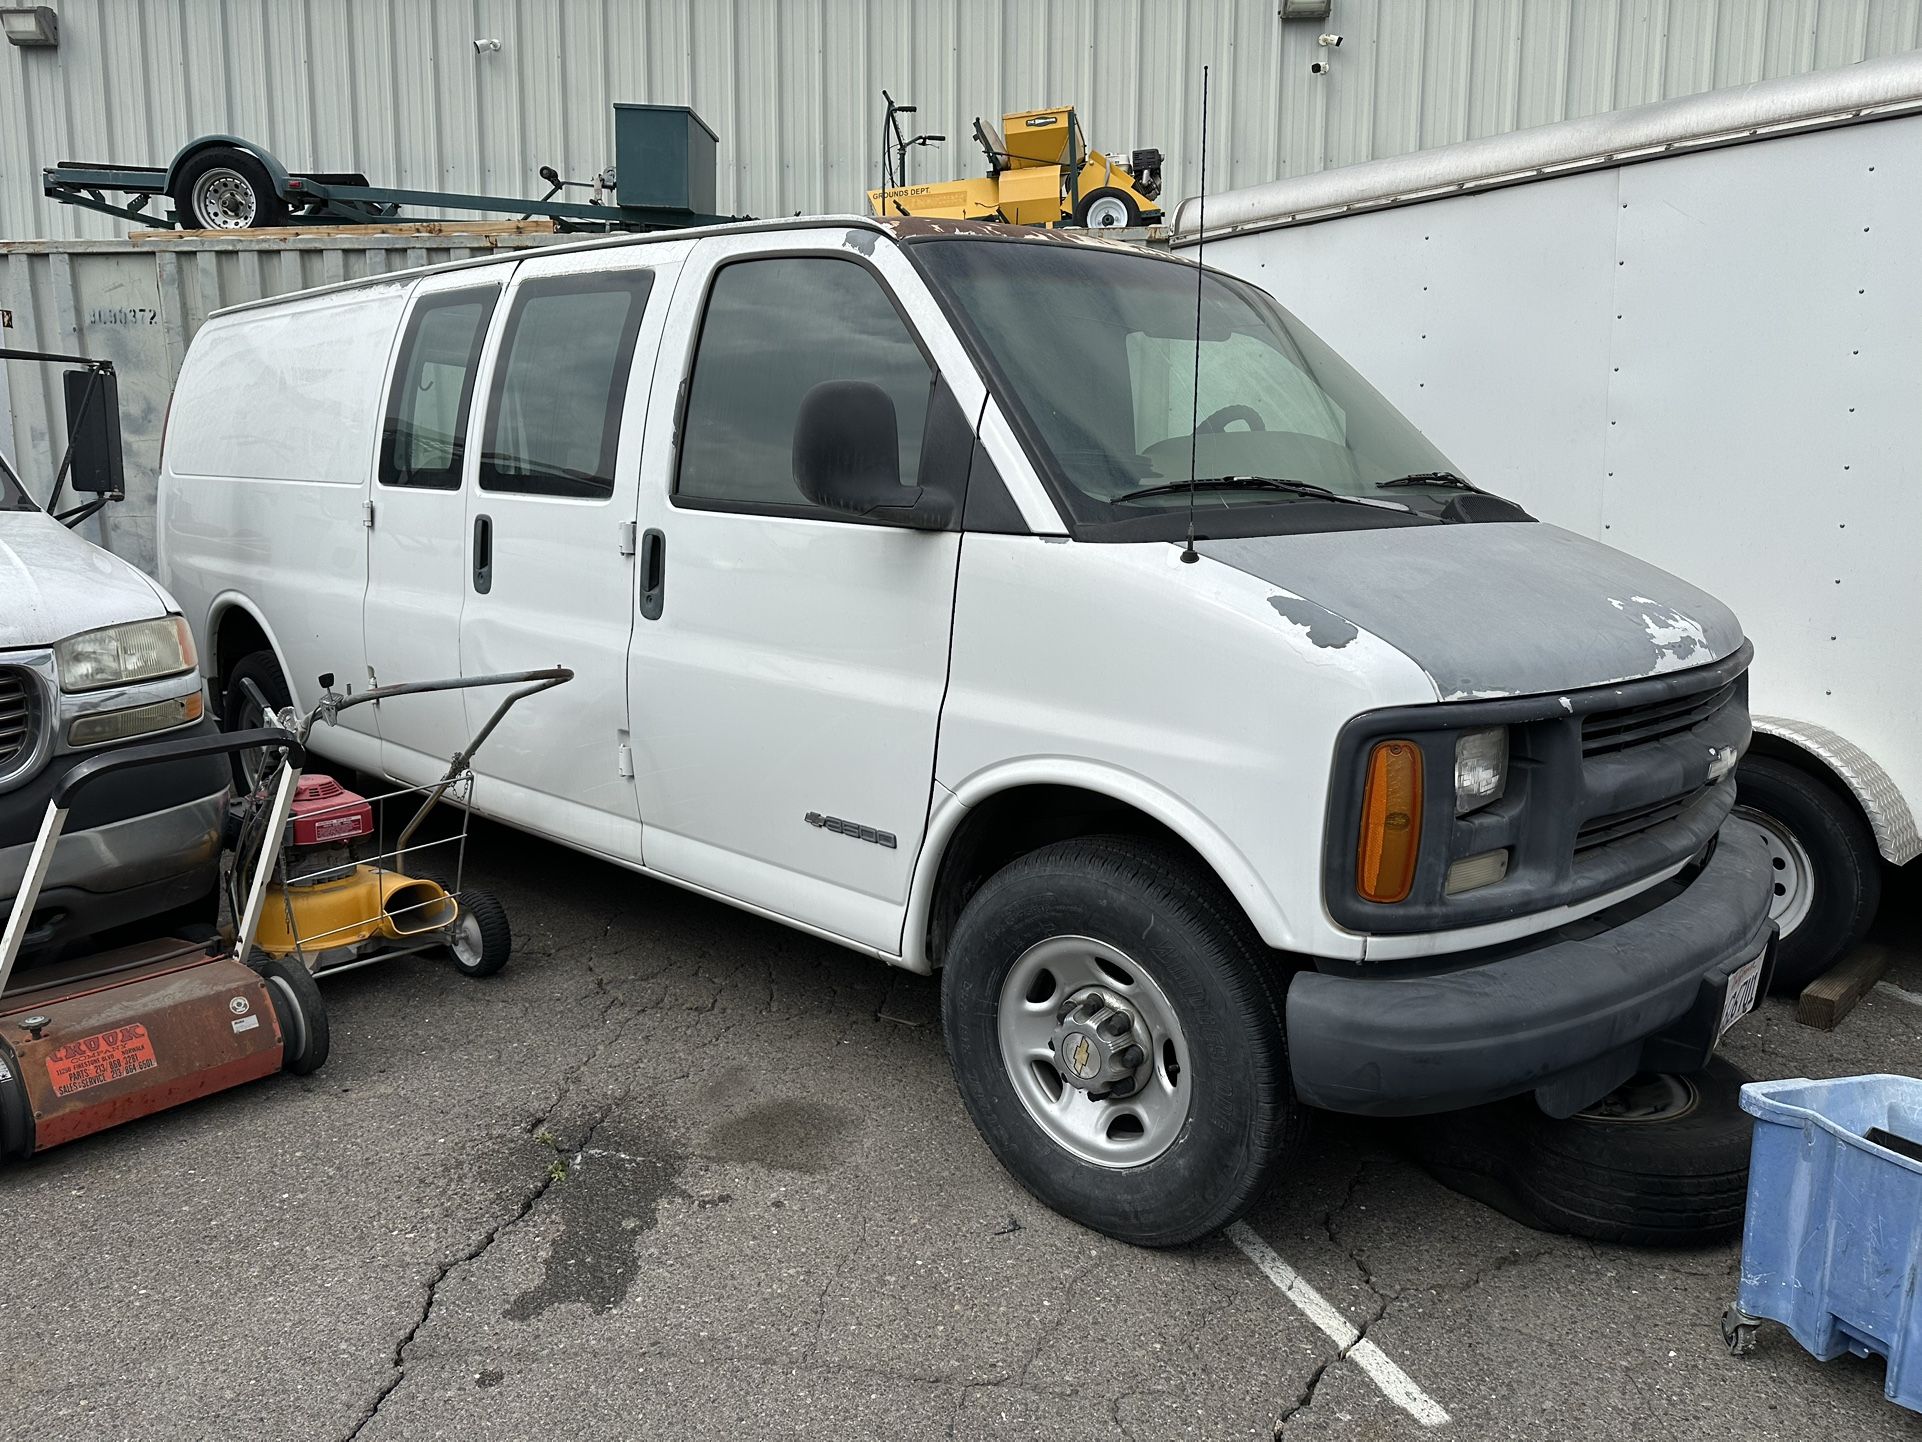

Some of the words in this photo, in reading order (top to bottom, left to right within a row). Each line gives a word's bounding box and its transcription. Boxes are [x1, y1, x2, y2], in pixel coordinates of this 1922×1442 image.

[872, 190, 909, 200] GROUNDS
[910, 187, 931, 196] DEPT.
[70, 1043, 127, 1063] COMPANY
[73, 1057, 100, 1070] FIRESTONE
